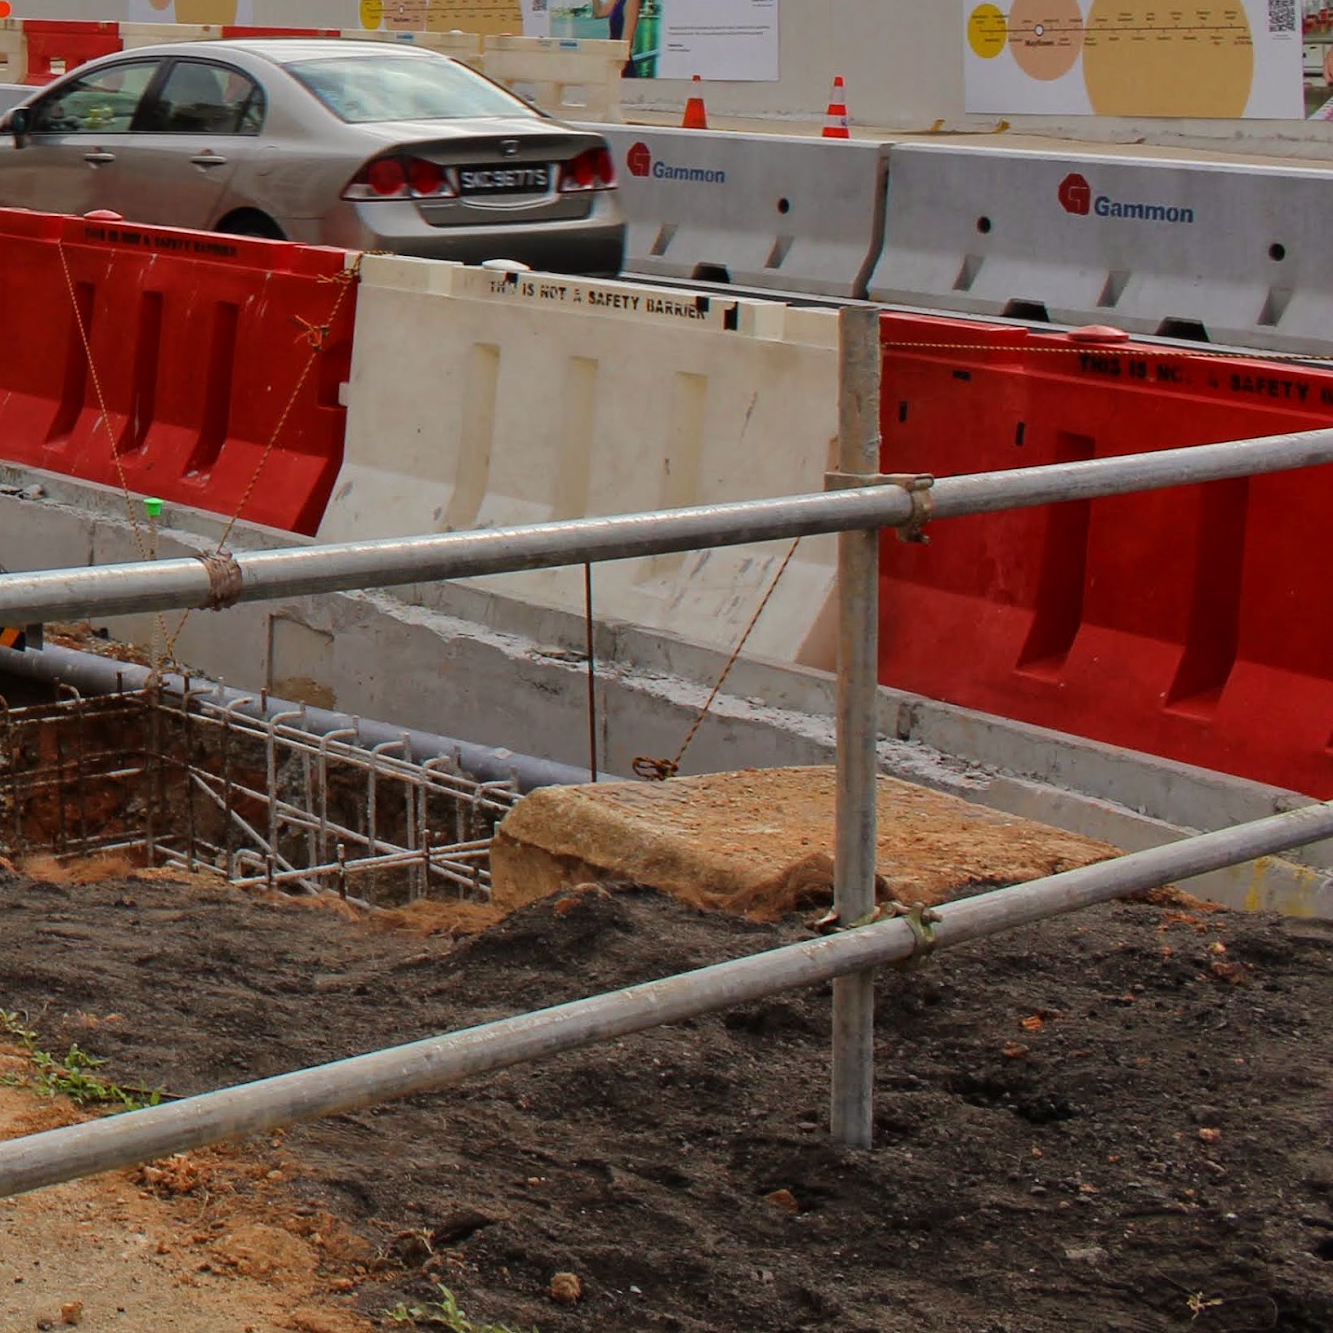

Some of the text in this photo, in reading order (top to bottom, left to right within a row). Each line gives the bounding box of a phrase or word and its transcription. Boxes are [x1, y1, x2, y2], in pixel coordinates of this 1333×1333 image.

[653, 161, 725, 183] Gammon
[1094, 196, 1194, 223] Gammon
[522, 283, 535, 297] IS
[540, 285, 567, 301] NOT
[588, 291, 640, 310] SAFETY
[1079, 353, 1121, 377] THIS
[1129, 359, 1147, 380] IS
[1230, 374, 1310, 403] SAFETY
